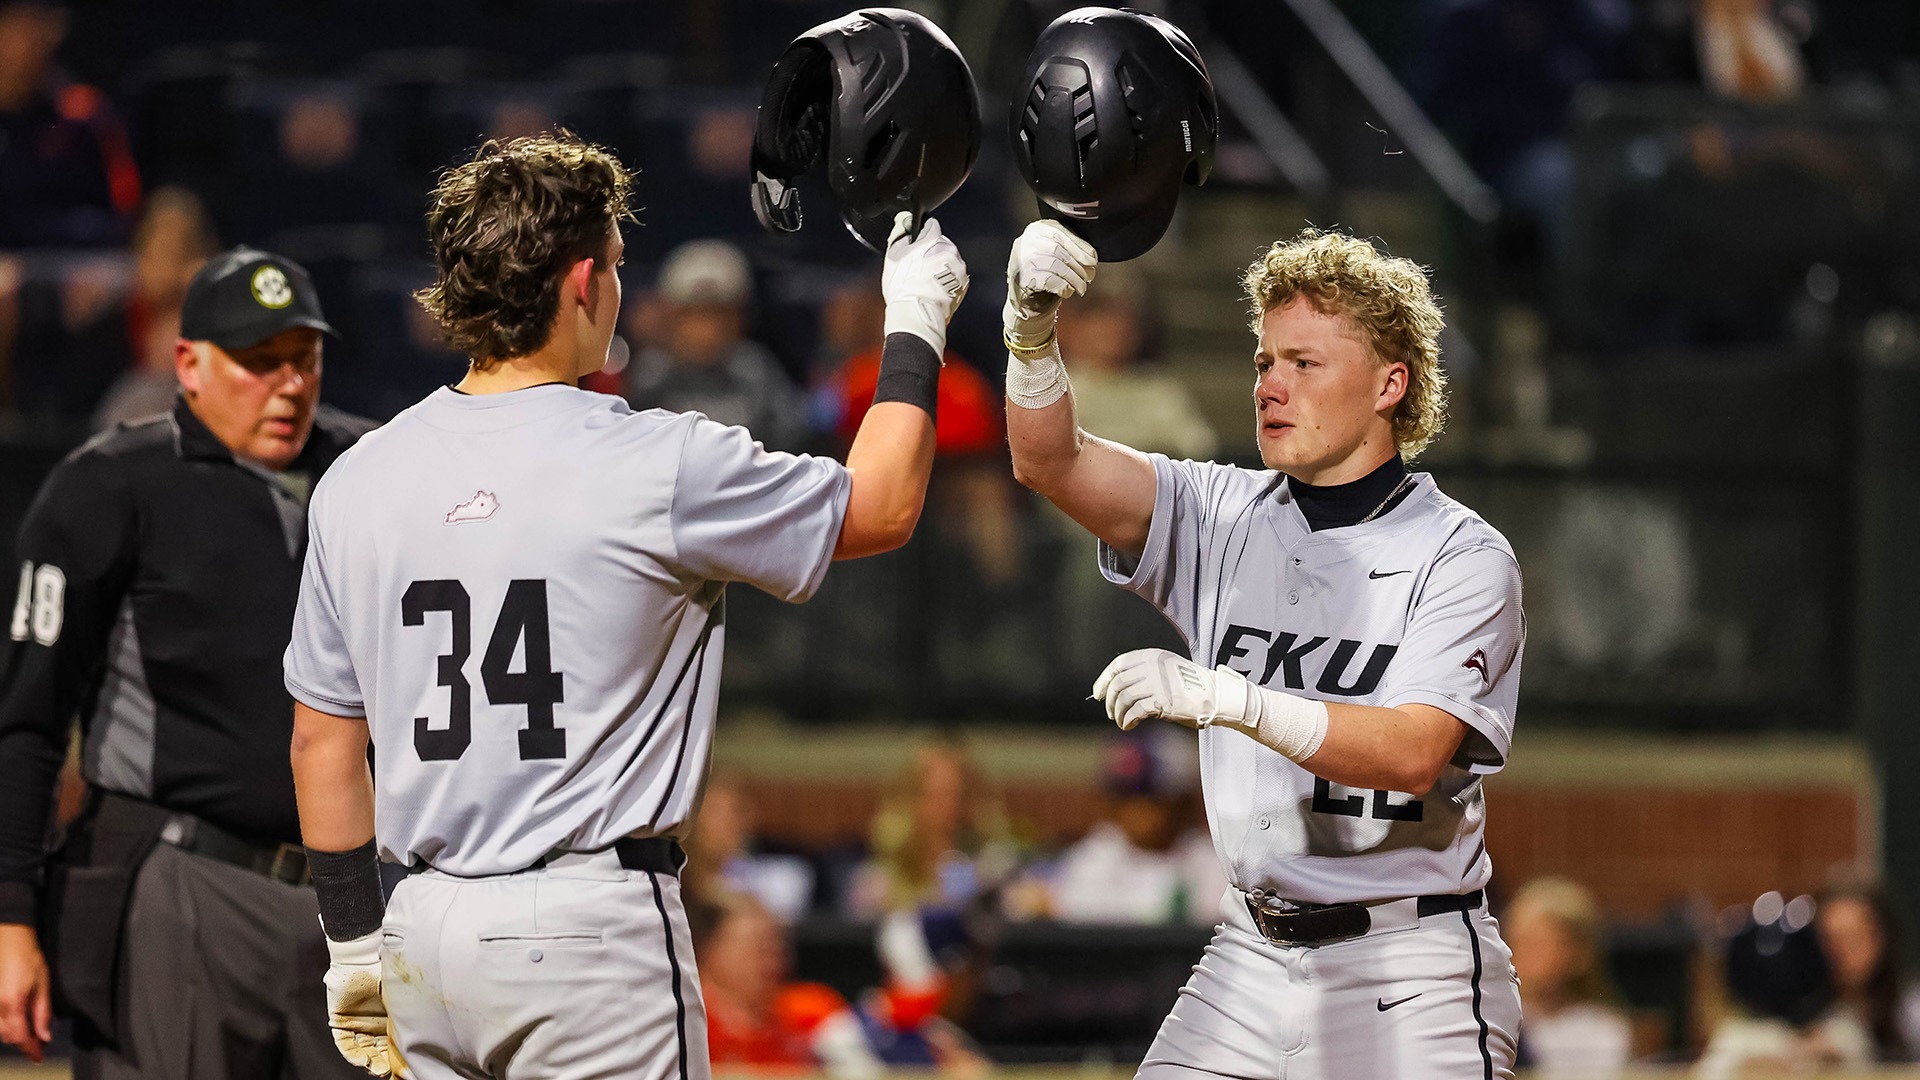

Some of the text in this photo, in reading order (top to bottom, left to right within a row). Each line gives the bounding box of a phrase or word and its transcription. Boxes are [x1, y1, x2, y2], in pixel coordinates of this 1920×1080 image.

[1180, 120, 1192, 152] marucci
[401, 579, 567, 762] 34
[1215, 623, 1399, 697] EKU
